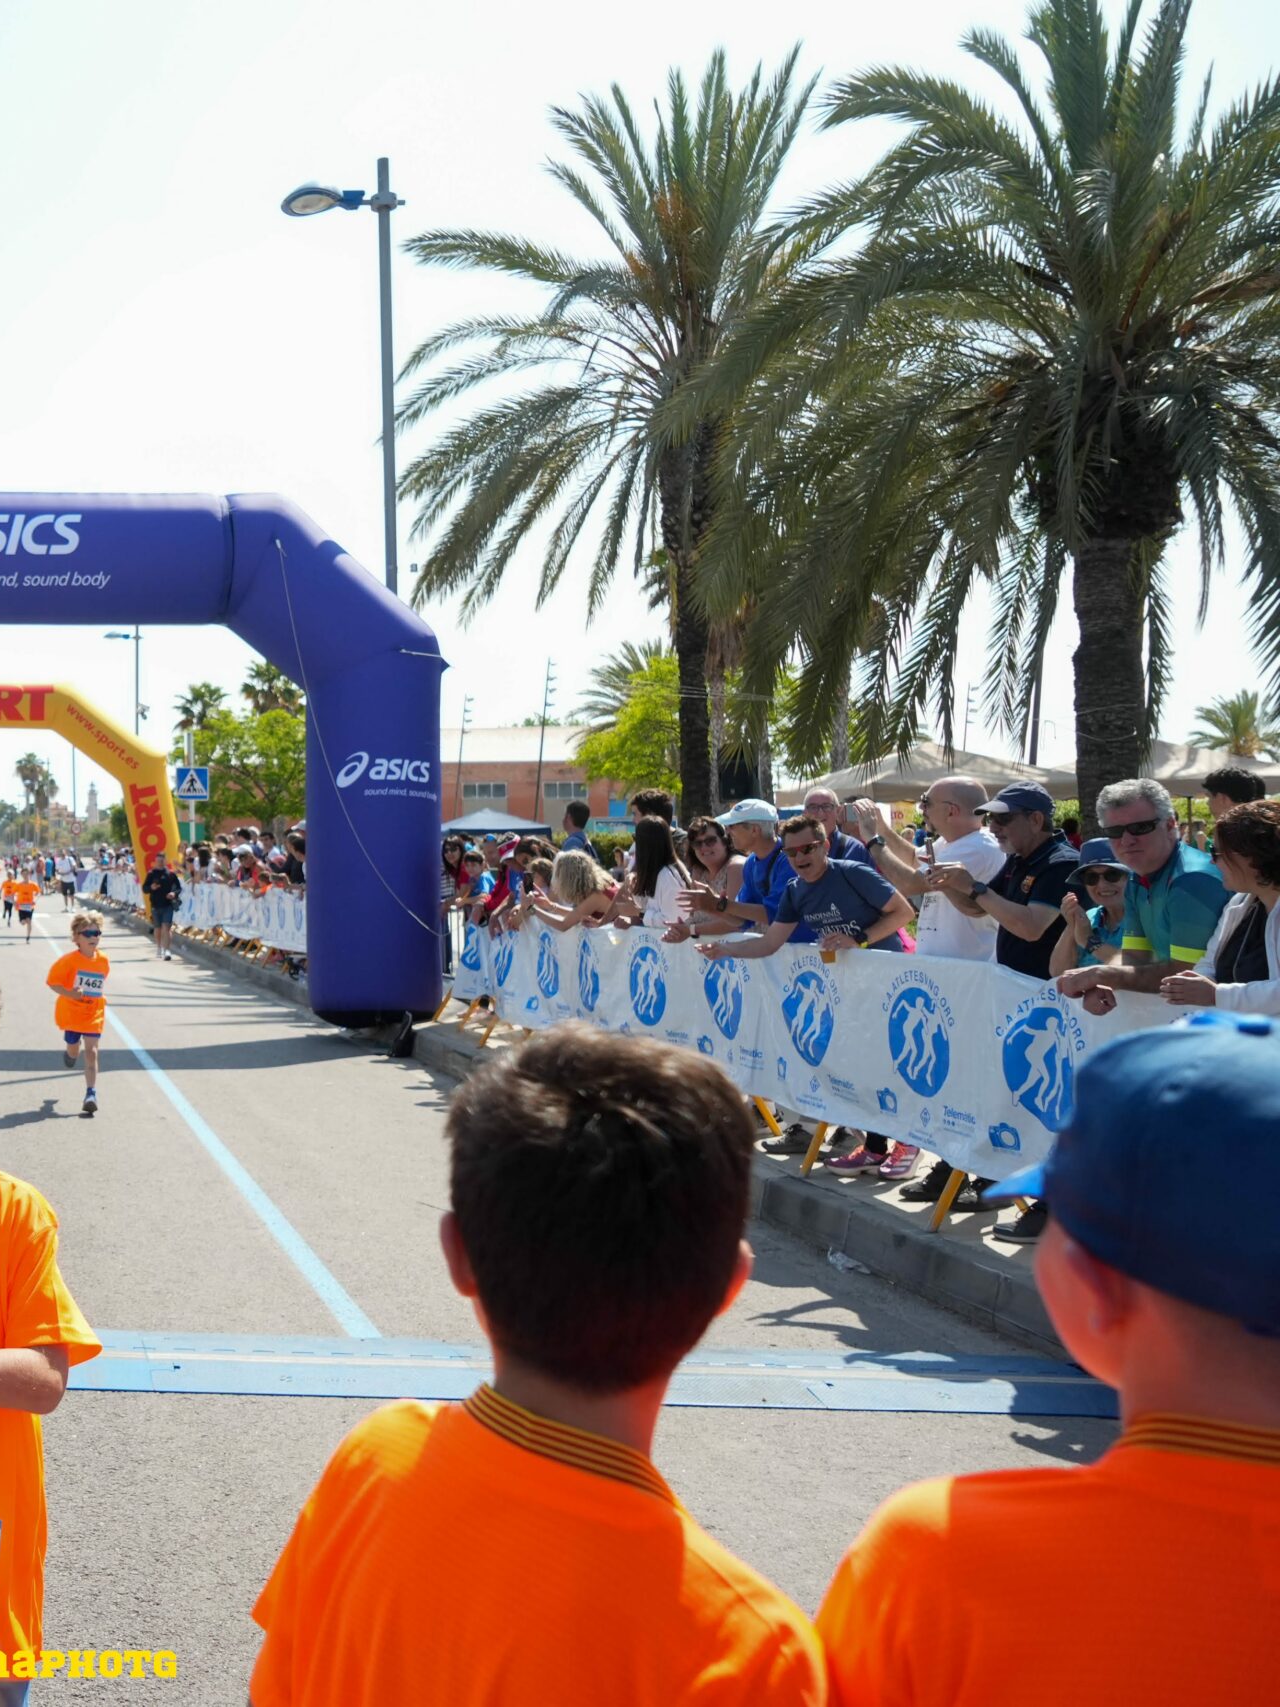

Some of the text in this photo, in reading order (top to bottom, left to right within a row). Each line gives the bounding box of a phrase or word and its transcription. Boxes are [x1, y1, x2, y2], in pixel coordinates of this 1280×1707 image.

[22, 572, 70, 587] sound
[71, 571, 111, 589] body
[66, 703, 141, 770] www.sport.es
[79, 977, 103, 989] 1462
